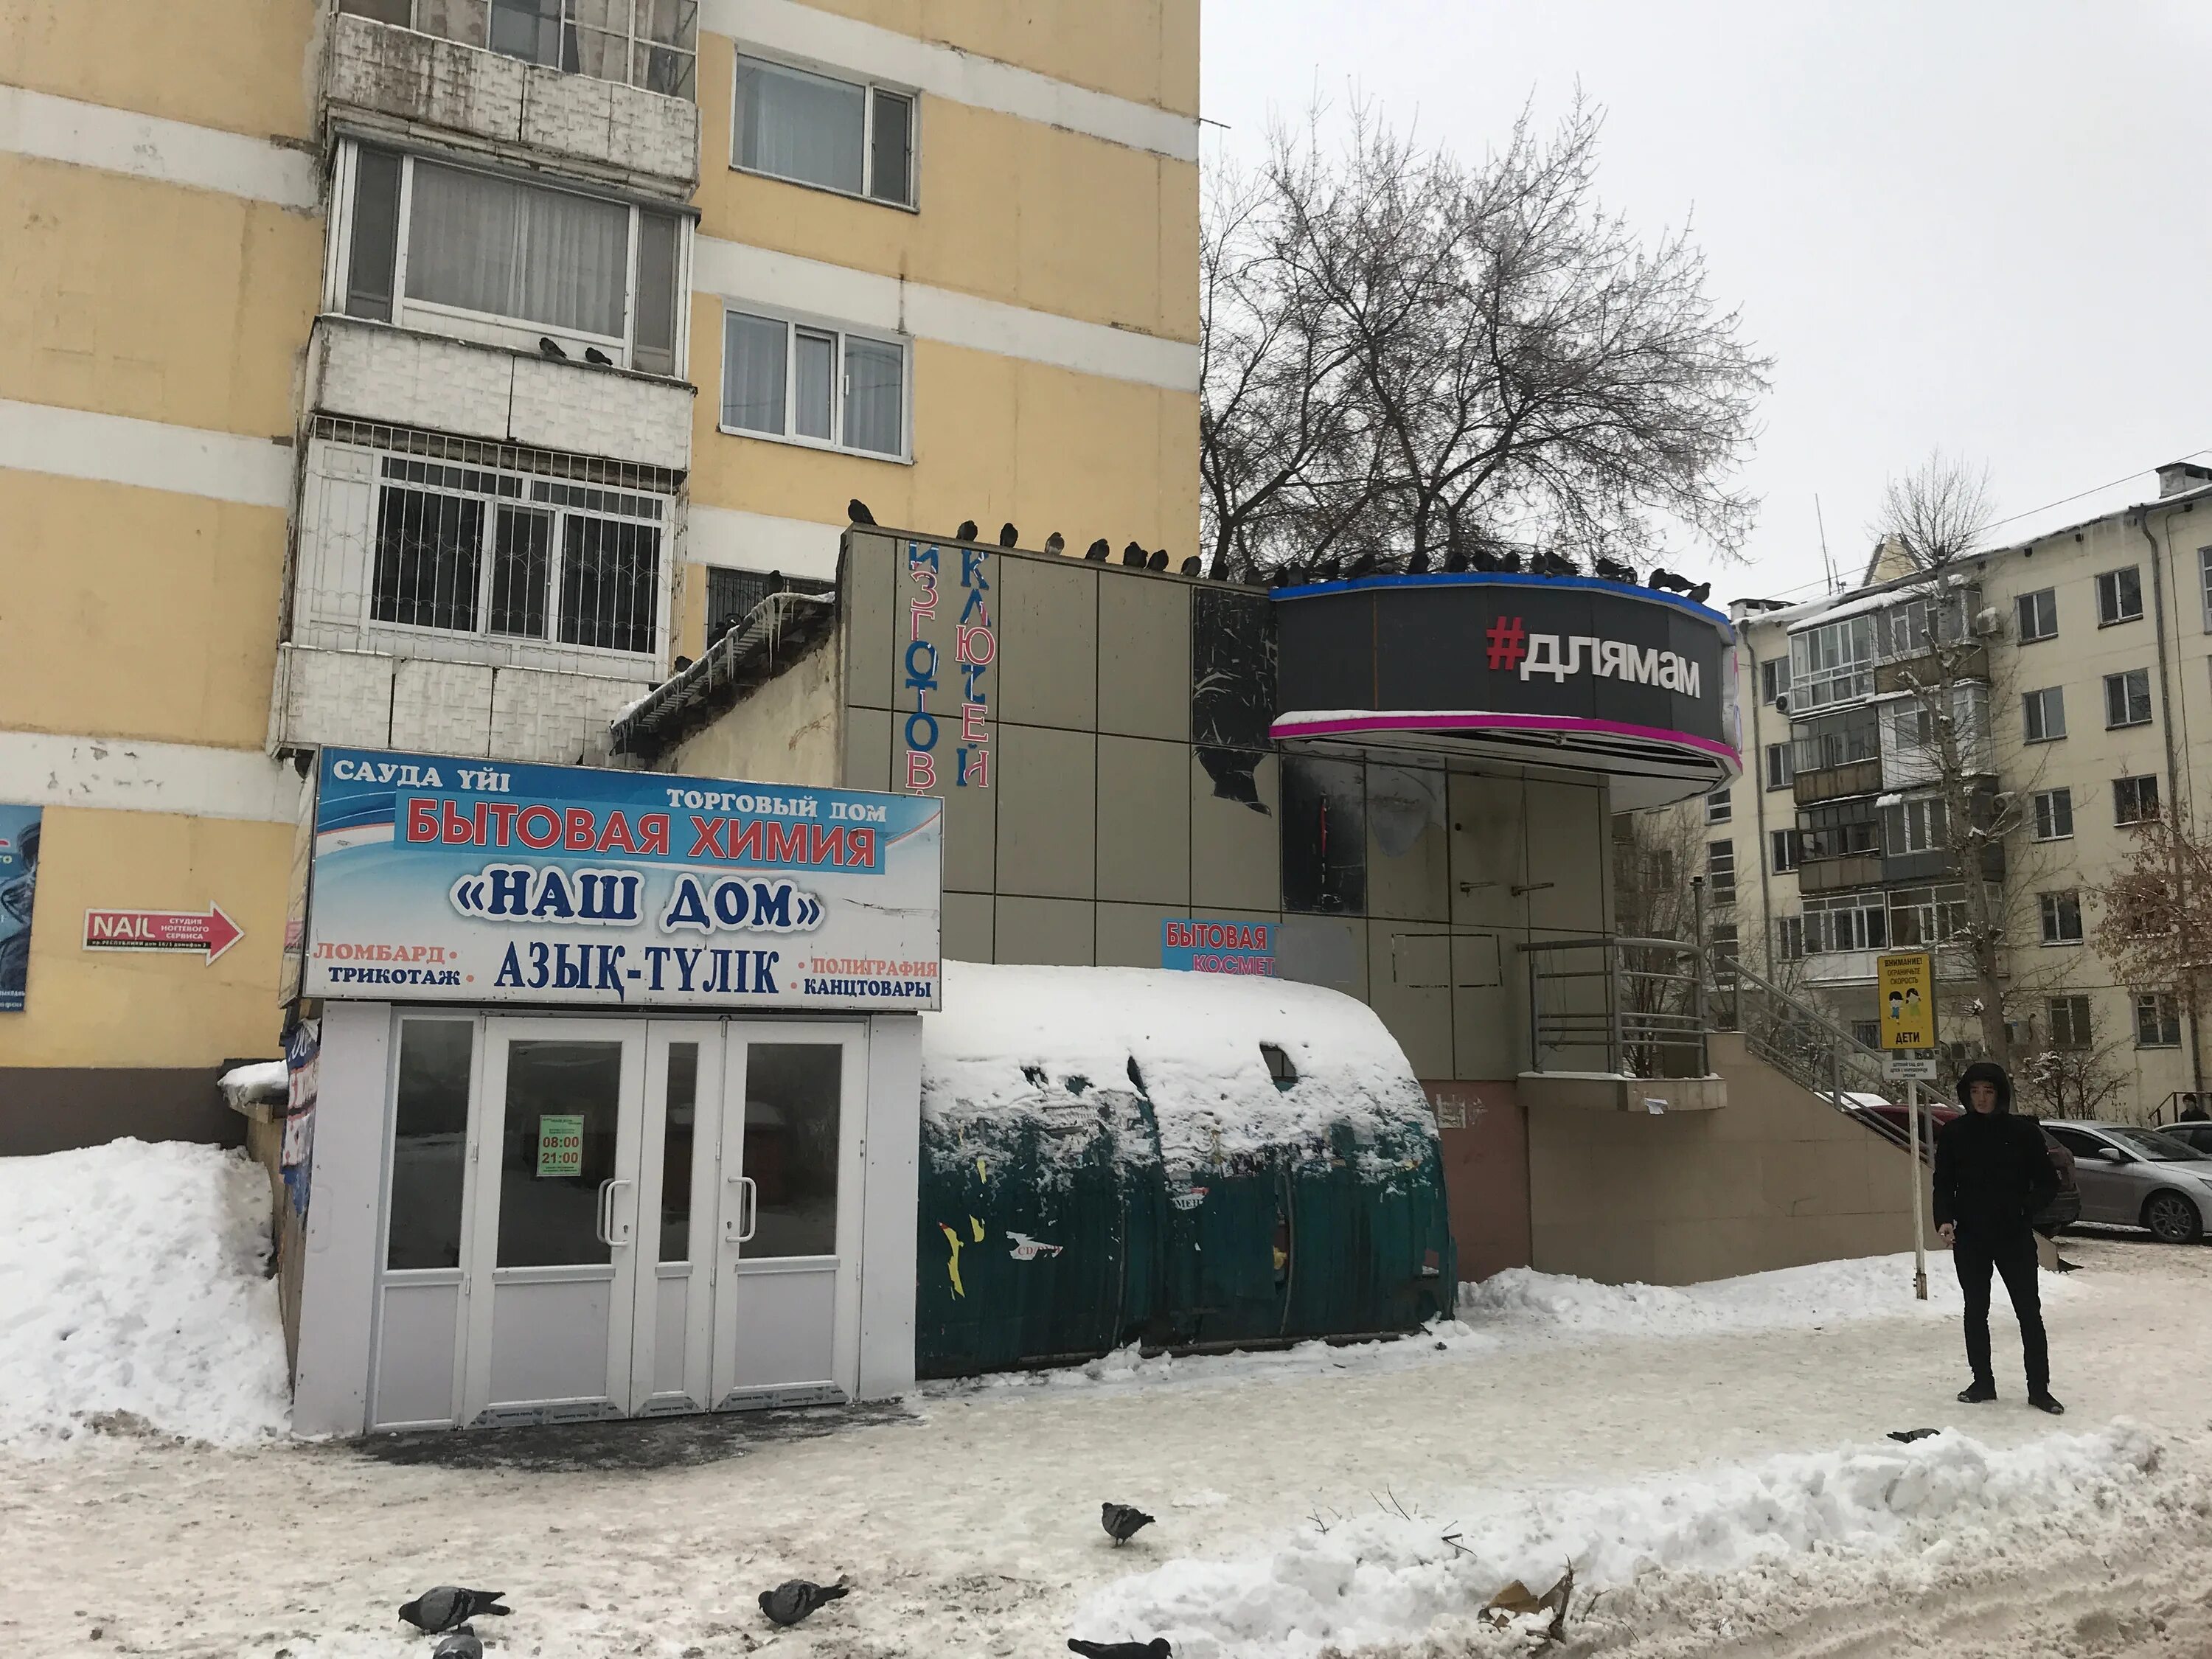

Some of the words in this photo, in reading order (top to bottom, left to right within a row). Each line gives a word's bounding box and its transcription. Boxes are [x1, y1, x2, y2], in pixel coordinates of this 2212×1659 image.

[905, 541, 939, 795] ИЗГОТОВ
[333, 759, 443, 787] САУДА
[666, 788, 818, 818] ТОРГОВЫЙ
[829, 801, 887, 823] ДОМ
[406, 797, 670, 857] БЫТОВАЯ
[687, 815, 876, 869] ХИМИЯ
[93, 916, 156, 939] NAIL
[161, 925, 209, 933] НОГТЕВОГО
[169, 917, 203, 925] СТУДИЯ
[166, 932, 204, 940] СЕРВИСА
[1166, 921, 1268, 951] БЫТОВАЯ
[313, 942, 446, 964] ЛОМБАРД
[1884, 957, 1923, 967] ВНИМАНИЕ!
[813, 958, 938, 978] ПОЛИГРАФИЯ
[1193, 954, 1279, 976] КОСМЕТ
[1887, 967, 1921, 976] ОГРАНИЧЬТЕ
[328, 966, 461, 987] ТРИКОТАЖ
[1890, 976, 1919, 985] СКОРОСТЬ
[804, 978, 932, 998] КАНЦТОВАРЫ
[1895, 1032, 1920, 1045] ДЕТИ
[543, 1136, 579, 1148] 08:00
[542, 1152, 579, 1164] 21:00
